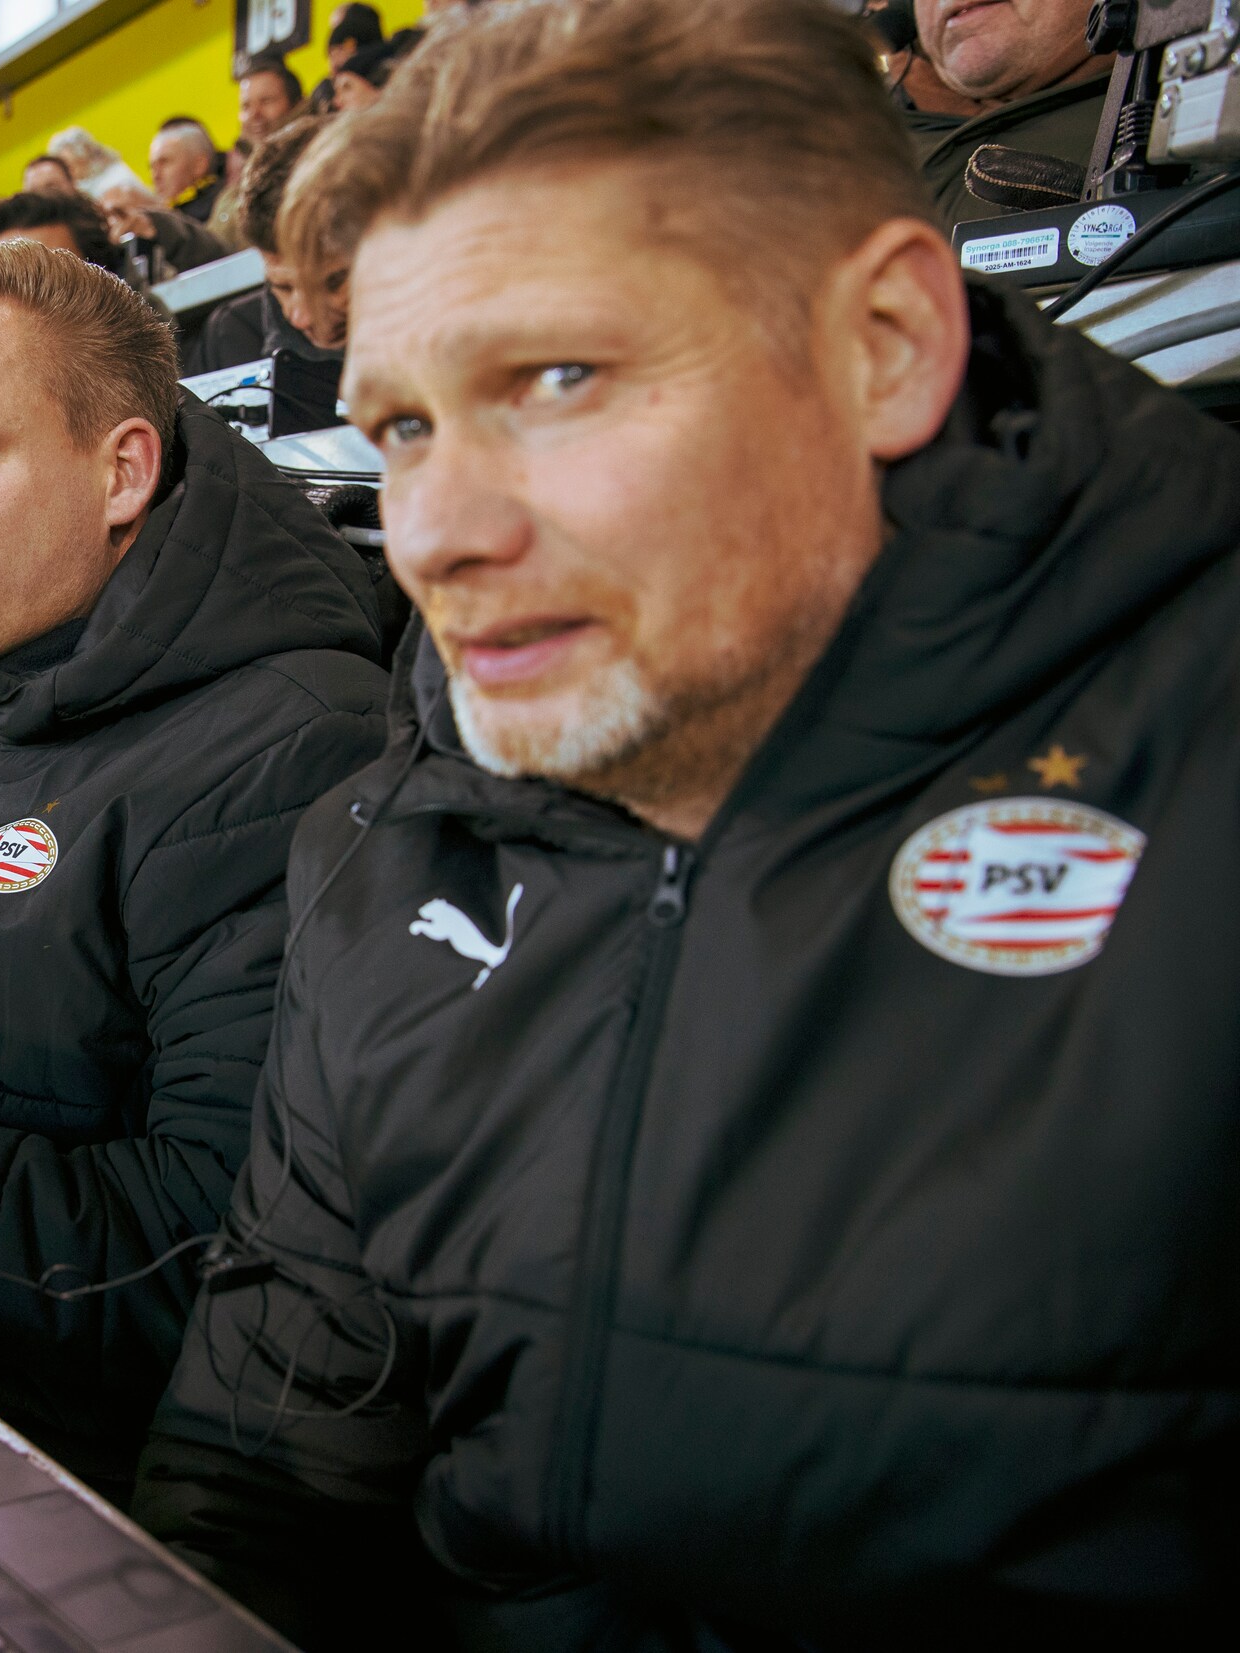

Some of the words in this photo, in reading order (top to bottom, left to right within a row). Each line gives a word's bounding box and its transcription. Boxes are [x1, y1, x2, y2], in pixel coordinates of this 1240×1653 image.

[1082, 221, 1123, 233] SYNORGA
[966, 242, 1001, 254] Synorga
[1002, 234, 1055, 247] 088-7966742
[984, 259, 1032, 271] 2025-AM-1624
[979, 862, 1069, 895] PSV
